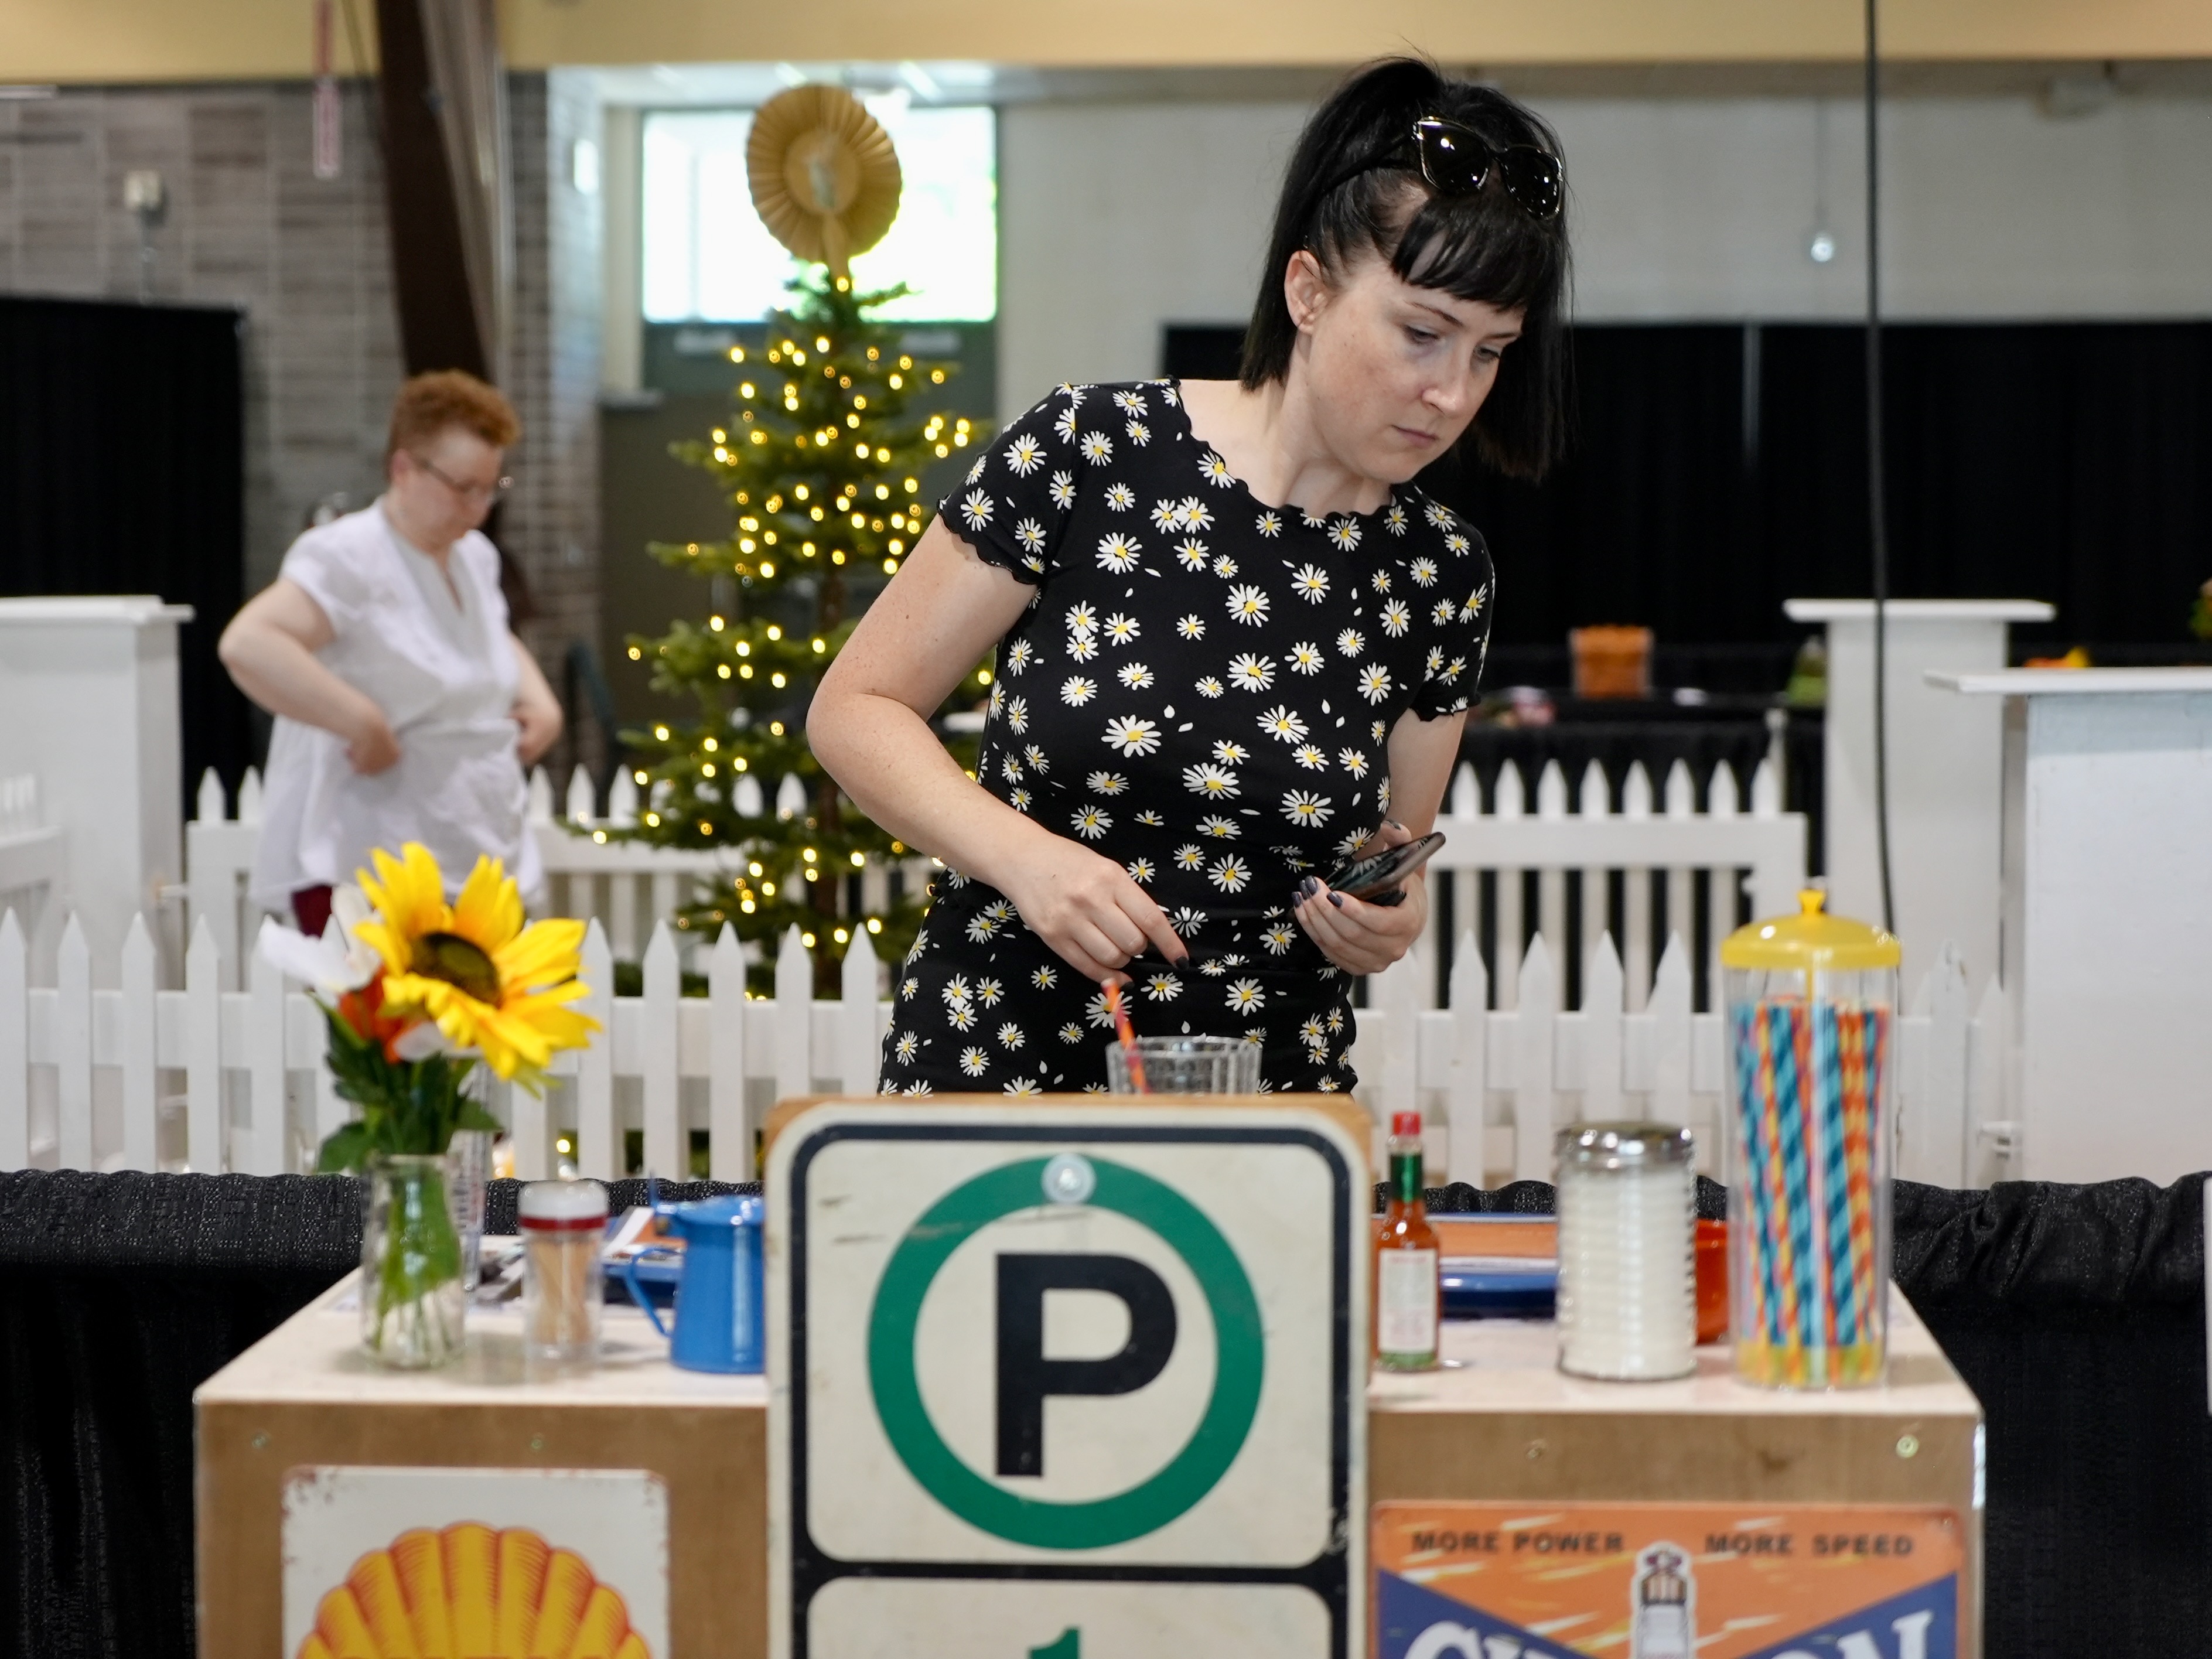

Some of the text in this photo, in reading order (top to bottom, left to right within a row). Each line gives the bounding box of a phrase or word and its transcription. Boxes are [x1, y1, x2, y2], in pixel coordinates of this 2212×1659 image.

[995, 1253, 1177, 1477] P
[1412, 1532, 1624, 1552] MORE POWER
[1705, 1533, 1913, 1555] MORE SPEED
